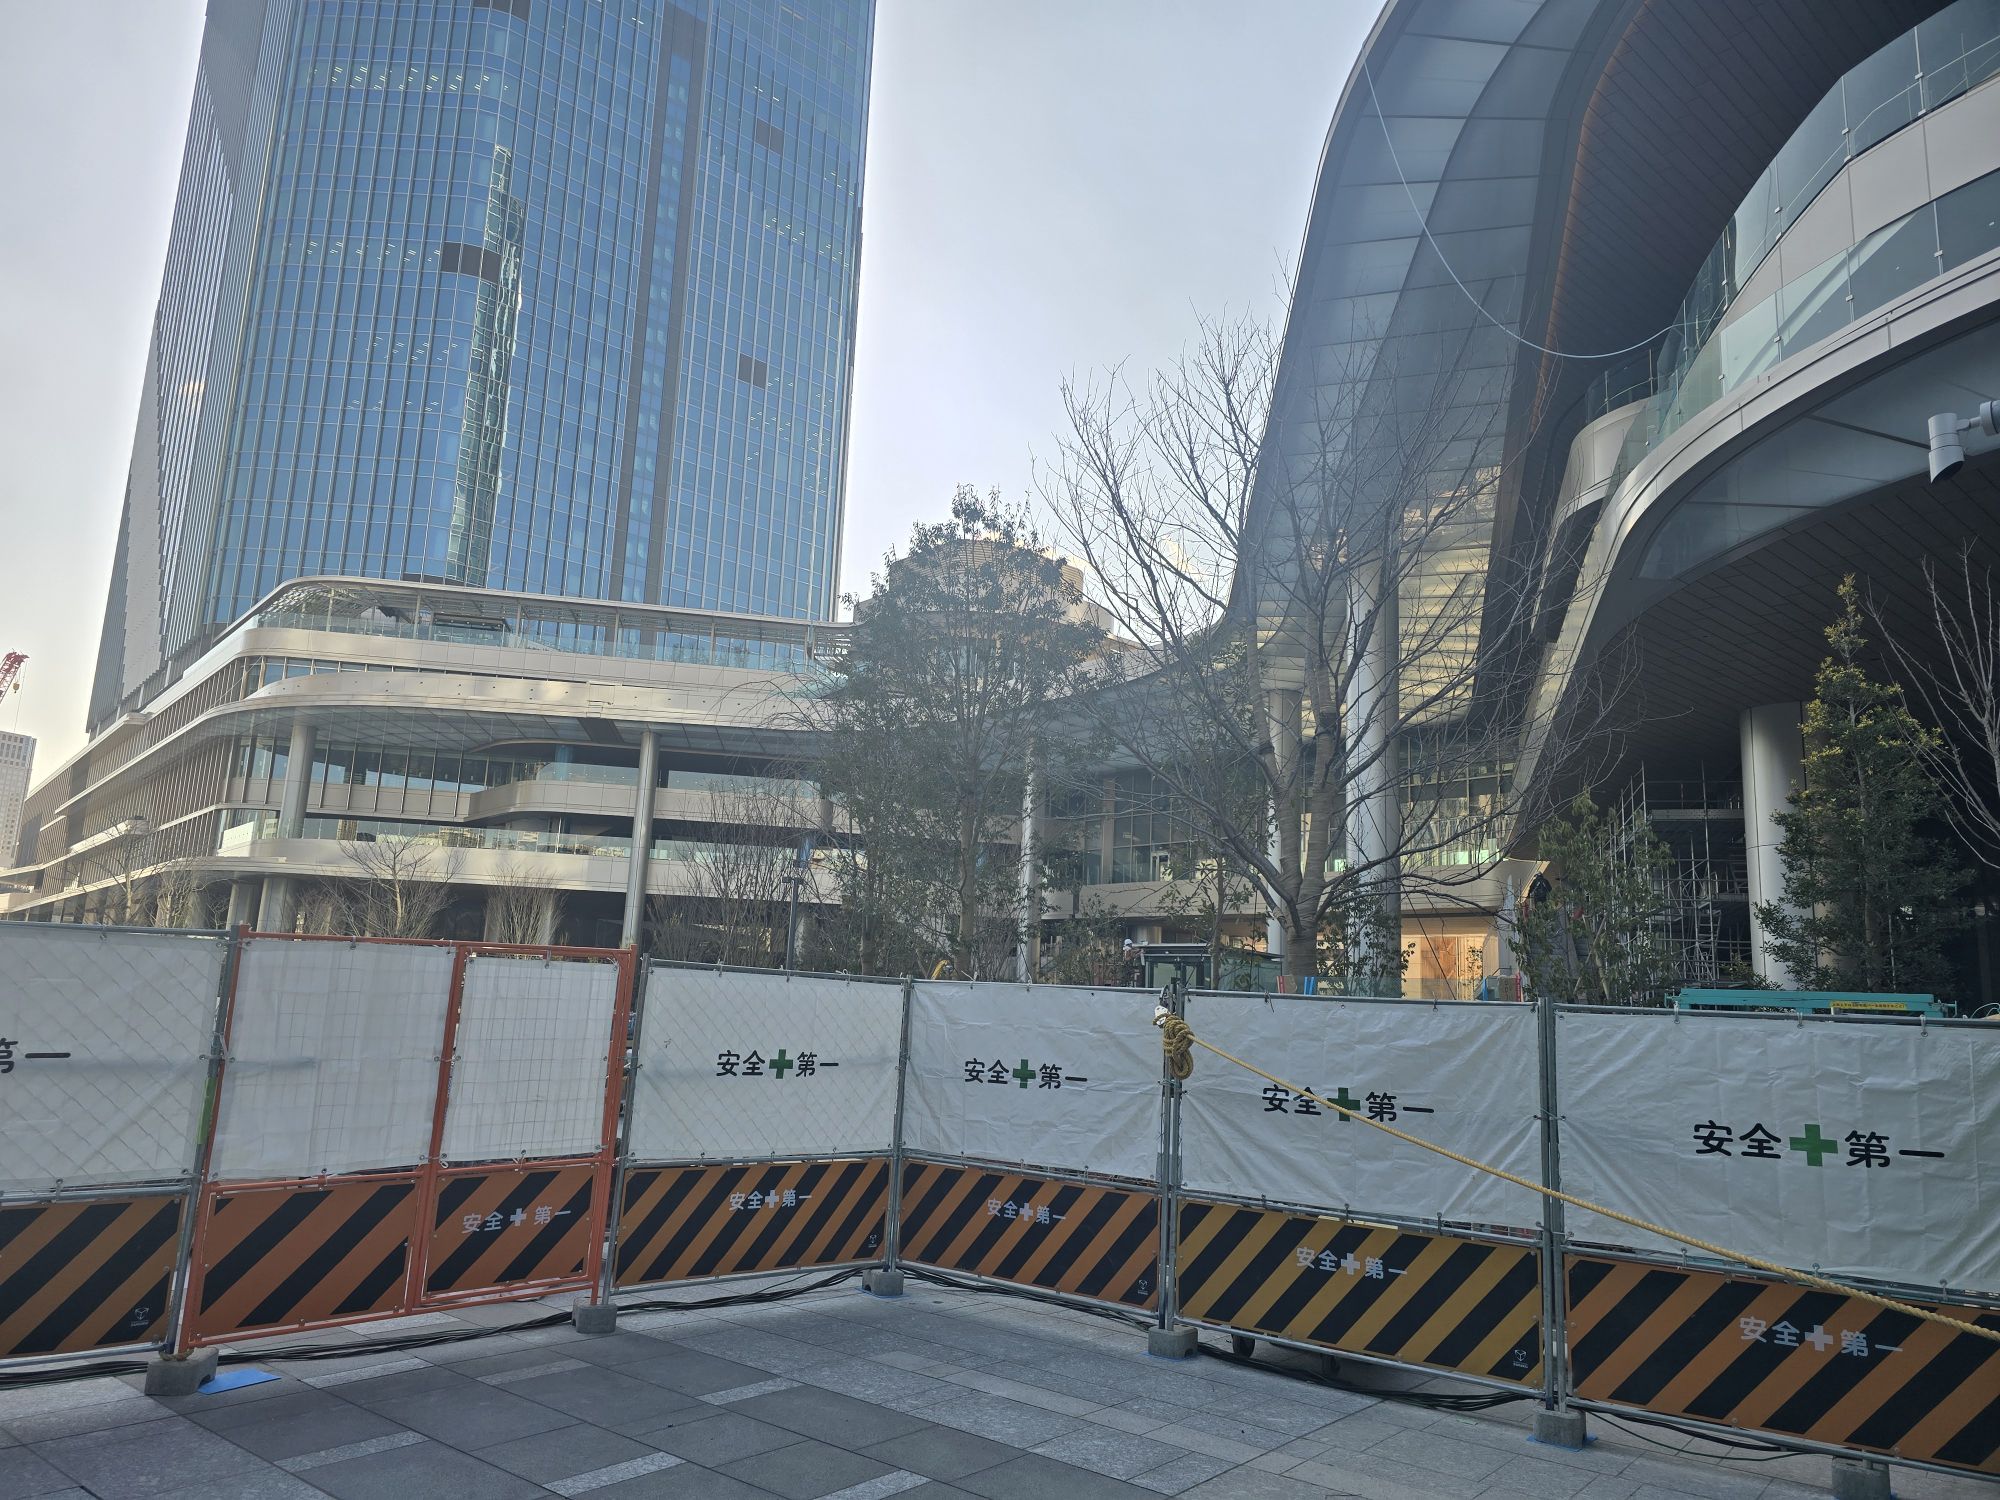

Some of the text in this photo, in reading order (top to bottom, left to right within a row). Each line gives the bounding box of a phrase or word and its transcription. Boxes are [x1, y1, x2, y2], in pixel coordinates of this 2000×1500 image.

[716, 1049, 839, 1077] 安全 第一
[964, 1058, 1088, 1089] 安全 第一
[1365, 1091, 1435, 1122] 第一
[1693, 1120, 1945, 1168] 安全 第一
[729, 1188, 812, 1211] 安全 第一
[987, 1197, 1066, 1224] 安全 第一
[462, 1206, 571, 1233] 安全 第一
[1296, 1247, 1407, 1279] 安全 第一
[1740, 1317, 1904, 1357] 安全 第一
